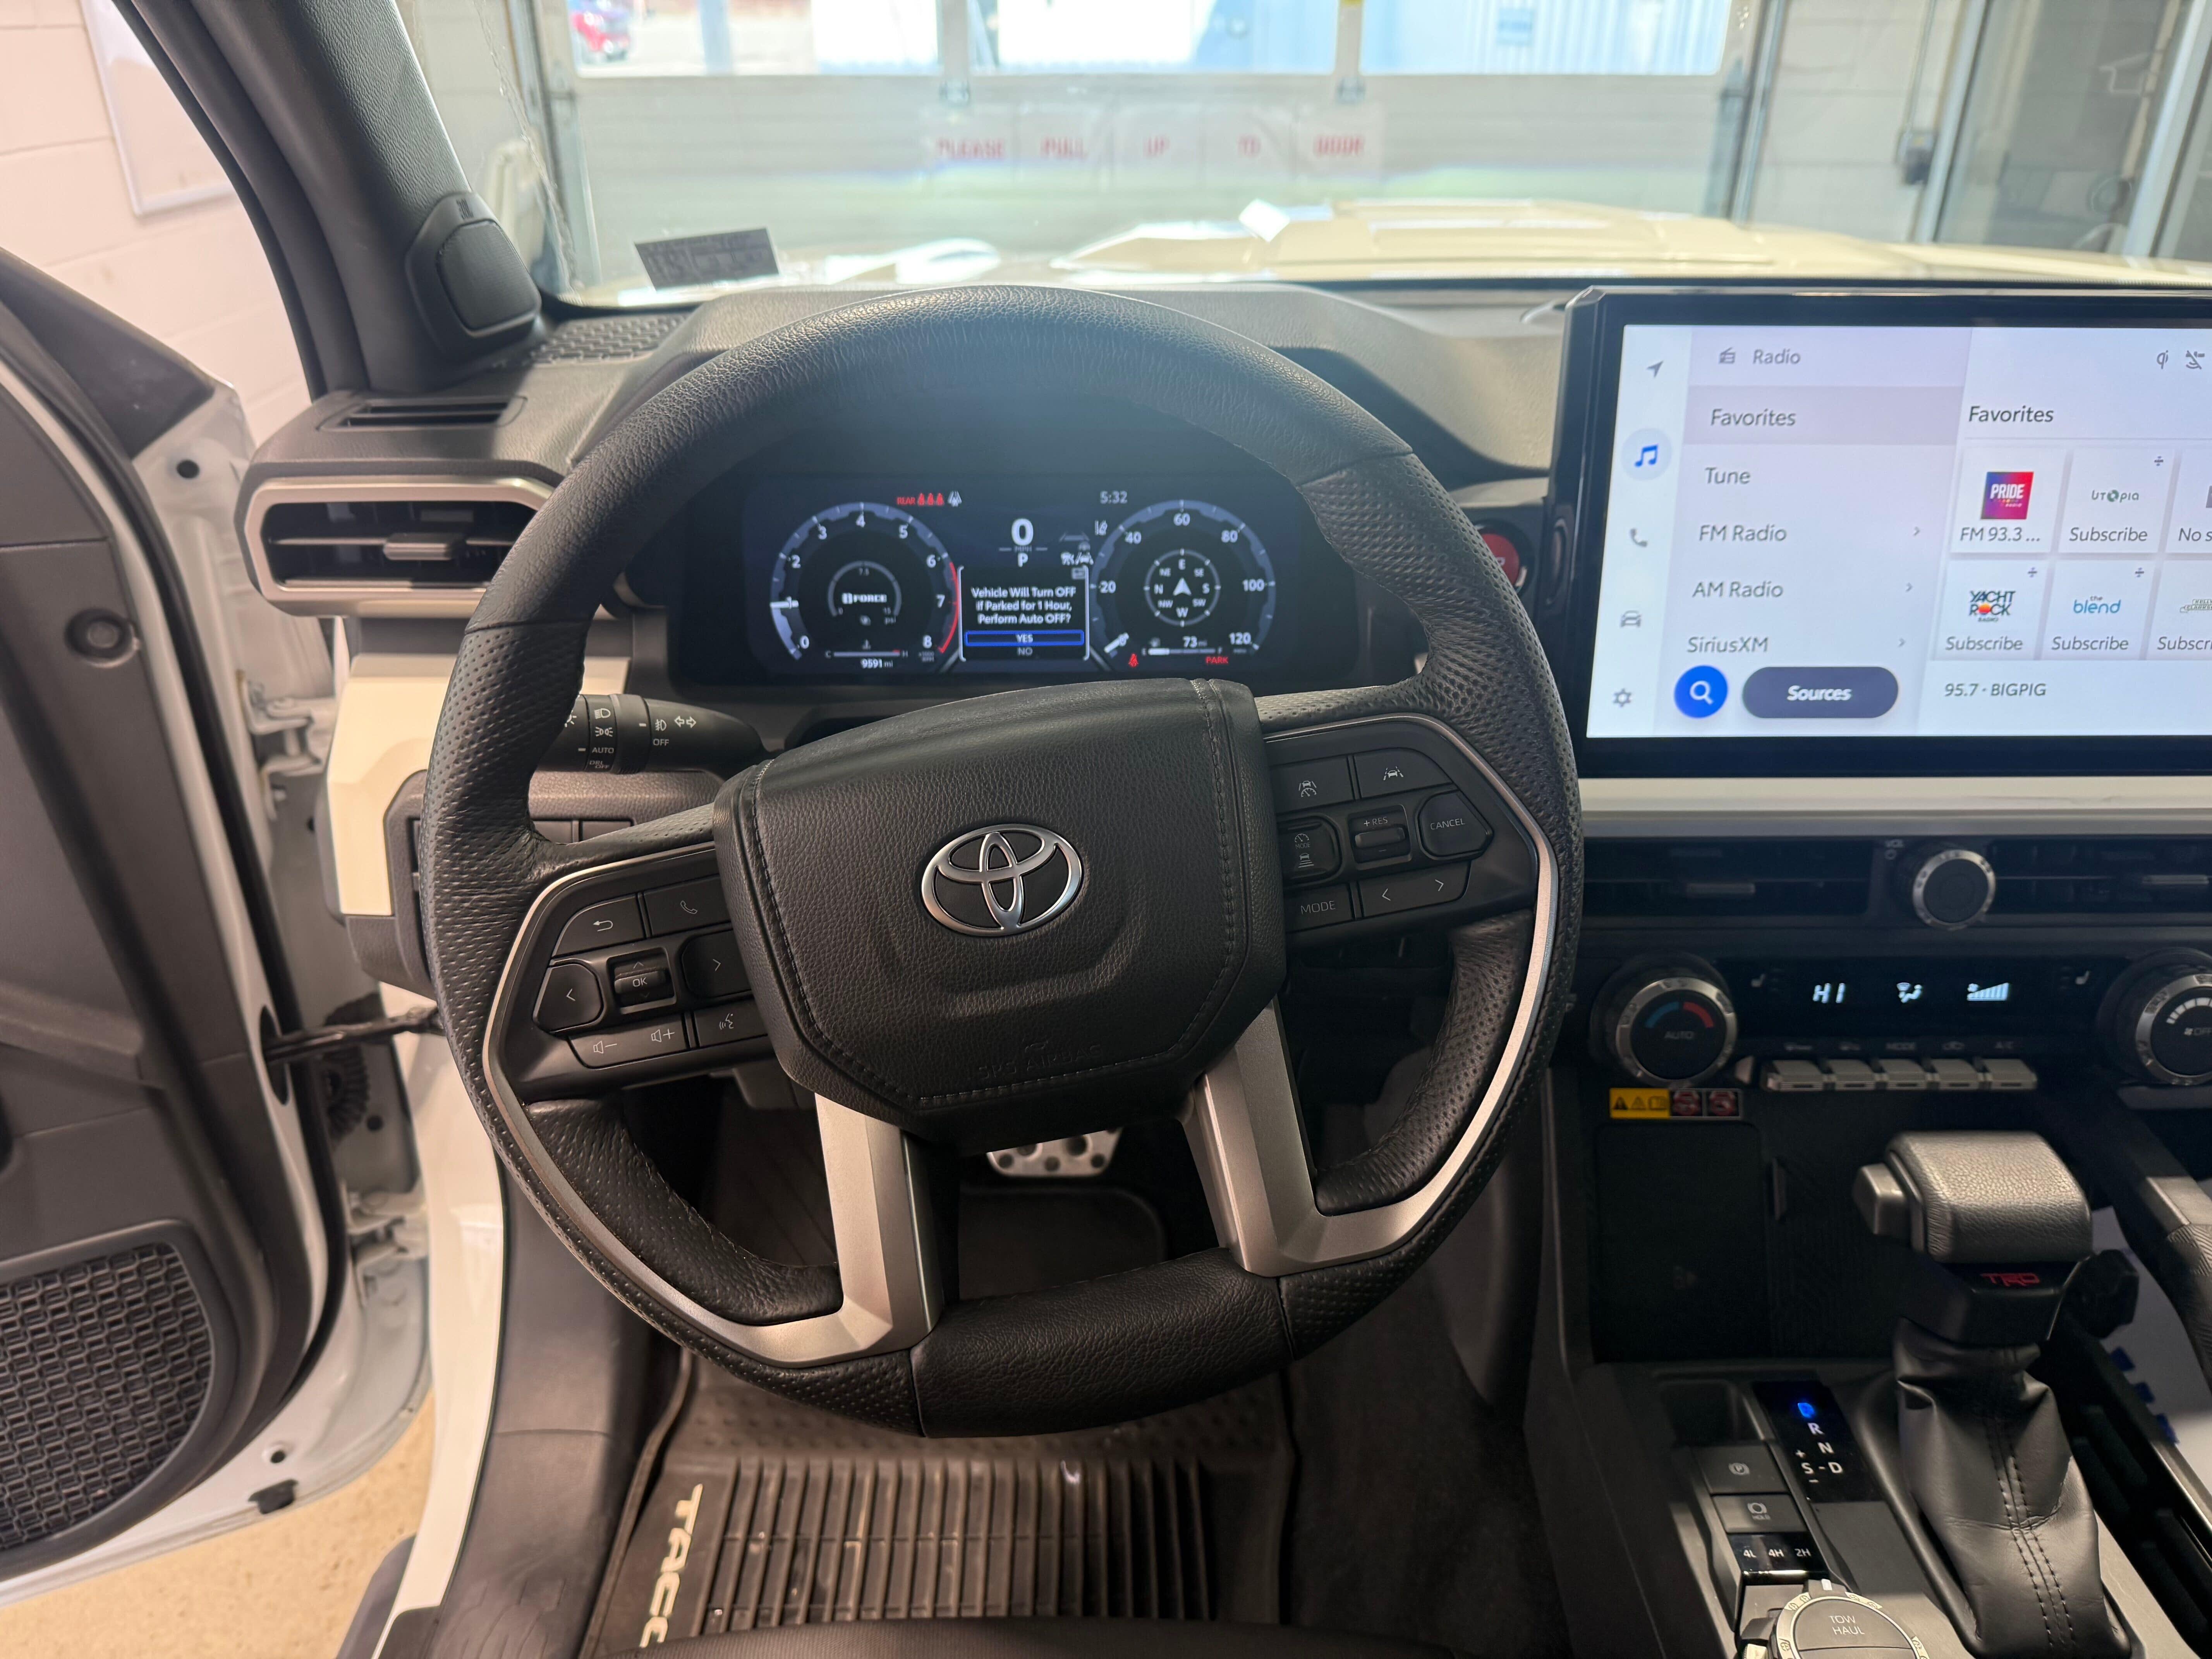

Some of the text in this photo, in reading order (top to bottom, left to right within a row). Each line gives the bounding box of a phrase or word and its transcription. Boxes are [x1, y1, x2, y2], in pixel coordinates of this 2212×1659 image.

[1753, 349, 1801, 364] Radio
[1710, 409, 1797, 426] Favorites
[1968, 406, 2054, 422] Favorites
[1705, 467, 1751, 484] Tune
[1100, 491, 1128, 504] 5:32
[1990, 484, 2025, 499] PRIDE
[856, 515, 866, 527] 4
[1173, 513, 1190, 526] 60
[818, 526, 828, 539] 3
[898, 525, 908, 539] 5
[1011, 518, 1034, 546] 0
[1125, 532, 1142, 544] 40
[1221, 531, 1238, 543] 80
[1699, 524, 1787, 541] FM Radio
[1960, 527, 1984, 542] FM
[1988, 527, 2022, 541] 93.3
[2069, 527, 2148, 542] Subscribe
[2178, 527, 2201, 541] No
[791, 555, 801, 568] 2
[927, 555, 936, 568] 6
[1018, 553, 1029, 567] P
[1179, 559, 1185, 570] E
[1159, 568, 1171, 577] NE
[1194, 568, 1204, 577] SE
[1100, 581, 1116, 593] 20
[1154, 584, 1163, 594] N
[1202, 583, 1210, 594] S
[1242, 579, 1265, 592] 100
[1692, 581, 1784, 598] AM Radio
[971, 587, 1076, 598] Vehicle Will Turn OFF
[1970, 591, 2016, 603] YACHT
[936, 594, 945, 608] 7
[986, 600, 1019, 611] Parked
[1021, 601, 1036, 611] for
[1038, 601, 1042, 610] 1
[2073, 599, 2121, 613] blend
[977, 613, 1071, 624] Perform Auto OFF?
[1176, 607, 1188, 618] W
[799, 635, 809, 648] 0
[922, 635, 933, 648] 8
[1016, 634, 1033, 643] YES
[1183, 636, 1197, 648] 73
[1229, 632, 1251, 645] 120
[1686, 637, 1769, 653] SiriusXM
[1945, 636, 2023, 651] Subscribe
[2052, 636, 2129, 651] Subscribe
[1017, 647, 1033, 656] NO
[1206, 656, 1229, 665] PARK
[1787, 685, 1852, 701] Sources
[1944, 683, 1978, 697] 95.7
[1990, 683, 2046, 696] BIGPIG
[1430, 818, 1465, 830] CANCEL
[1300, 900, 1336, 915] MODE
[632, 976, 647, 988] OK
[1980, 1273, 2040, 1287] TRD
[1807, 1422, 1825, 1435] R
[1817, 1442, 1834, 1453] N
[1802, 1462, 1843, 1474] S D
[1743, 1549, 1757, 1558] 4L
[1769, 1549, 1784, 1558] 4H
[1795, 1548, 1811, 1557] 2H
[1829, 1615, 1855, 1624] TOW
[1832, 1627, 1865, 1635] HAUL
